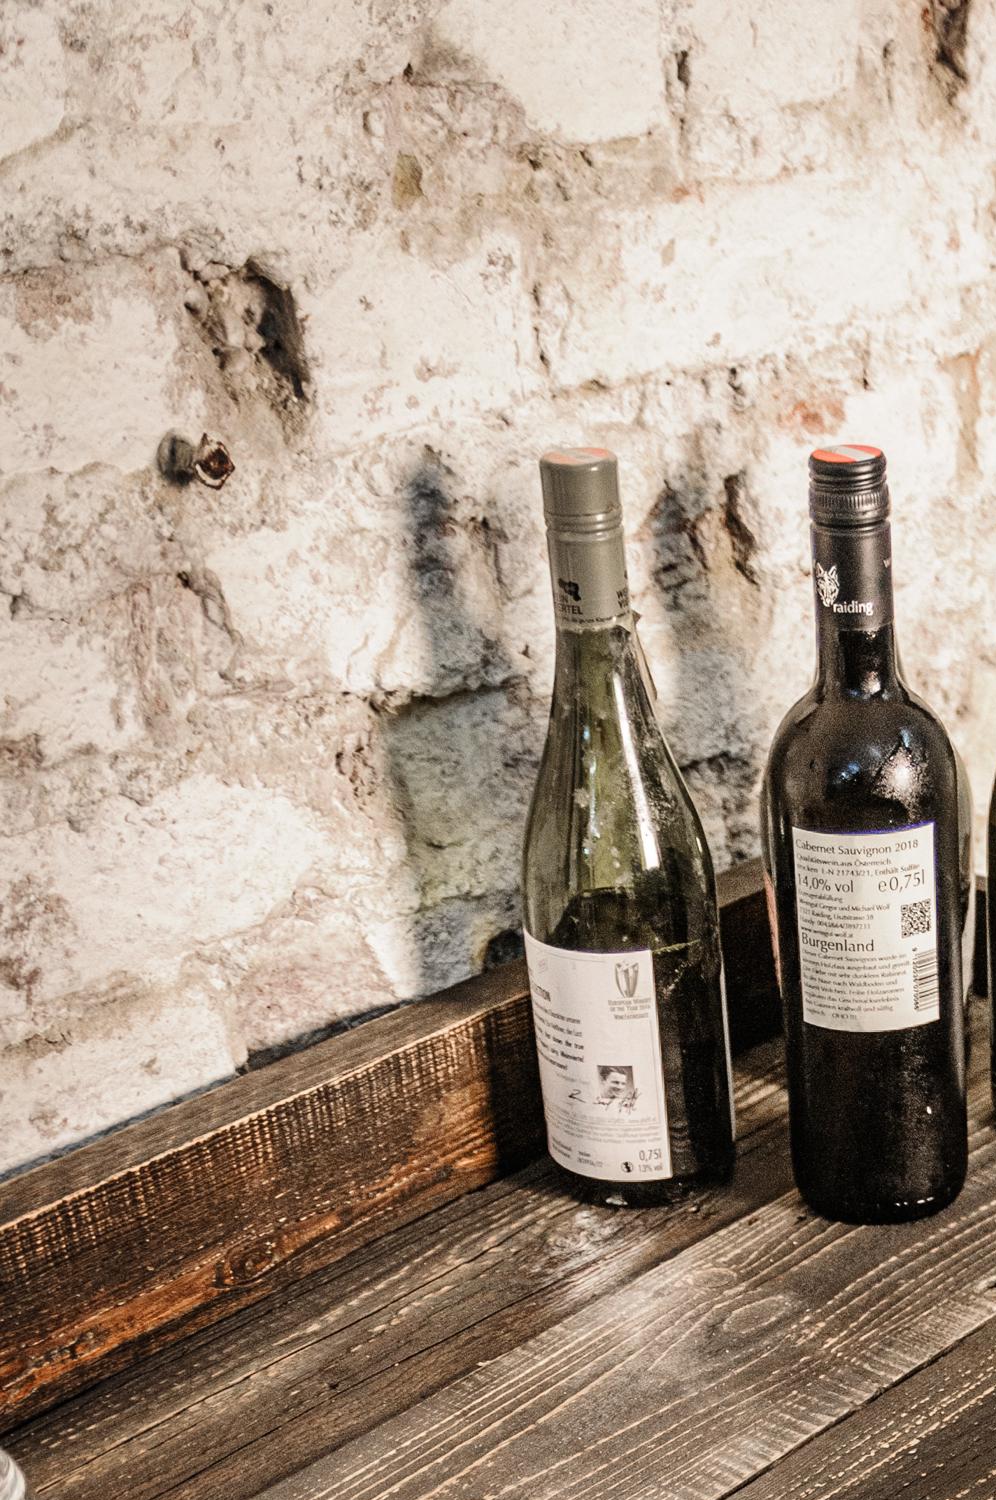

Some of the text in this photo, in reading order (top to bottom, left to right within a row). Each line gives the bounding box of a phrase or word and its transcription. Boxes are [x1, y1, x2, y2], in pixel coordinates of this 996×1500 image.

[833, 600, 874, 616] raiding
[795, 839, 919, 857] Cabernet Sauvignon 2018
[798, 873, 831, 891] 14,0%
[835, 879, 854, 893] vol
[802, 932, 874, 953] Burgenland
[639, 1148, 662, 1161] 0,75l
